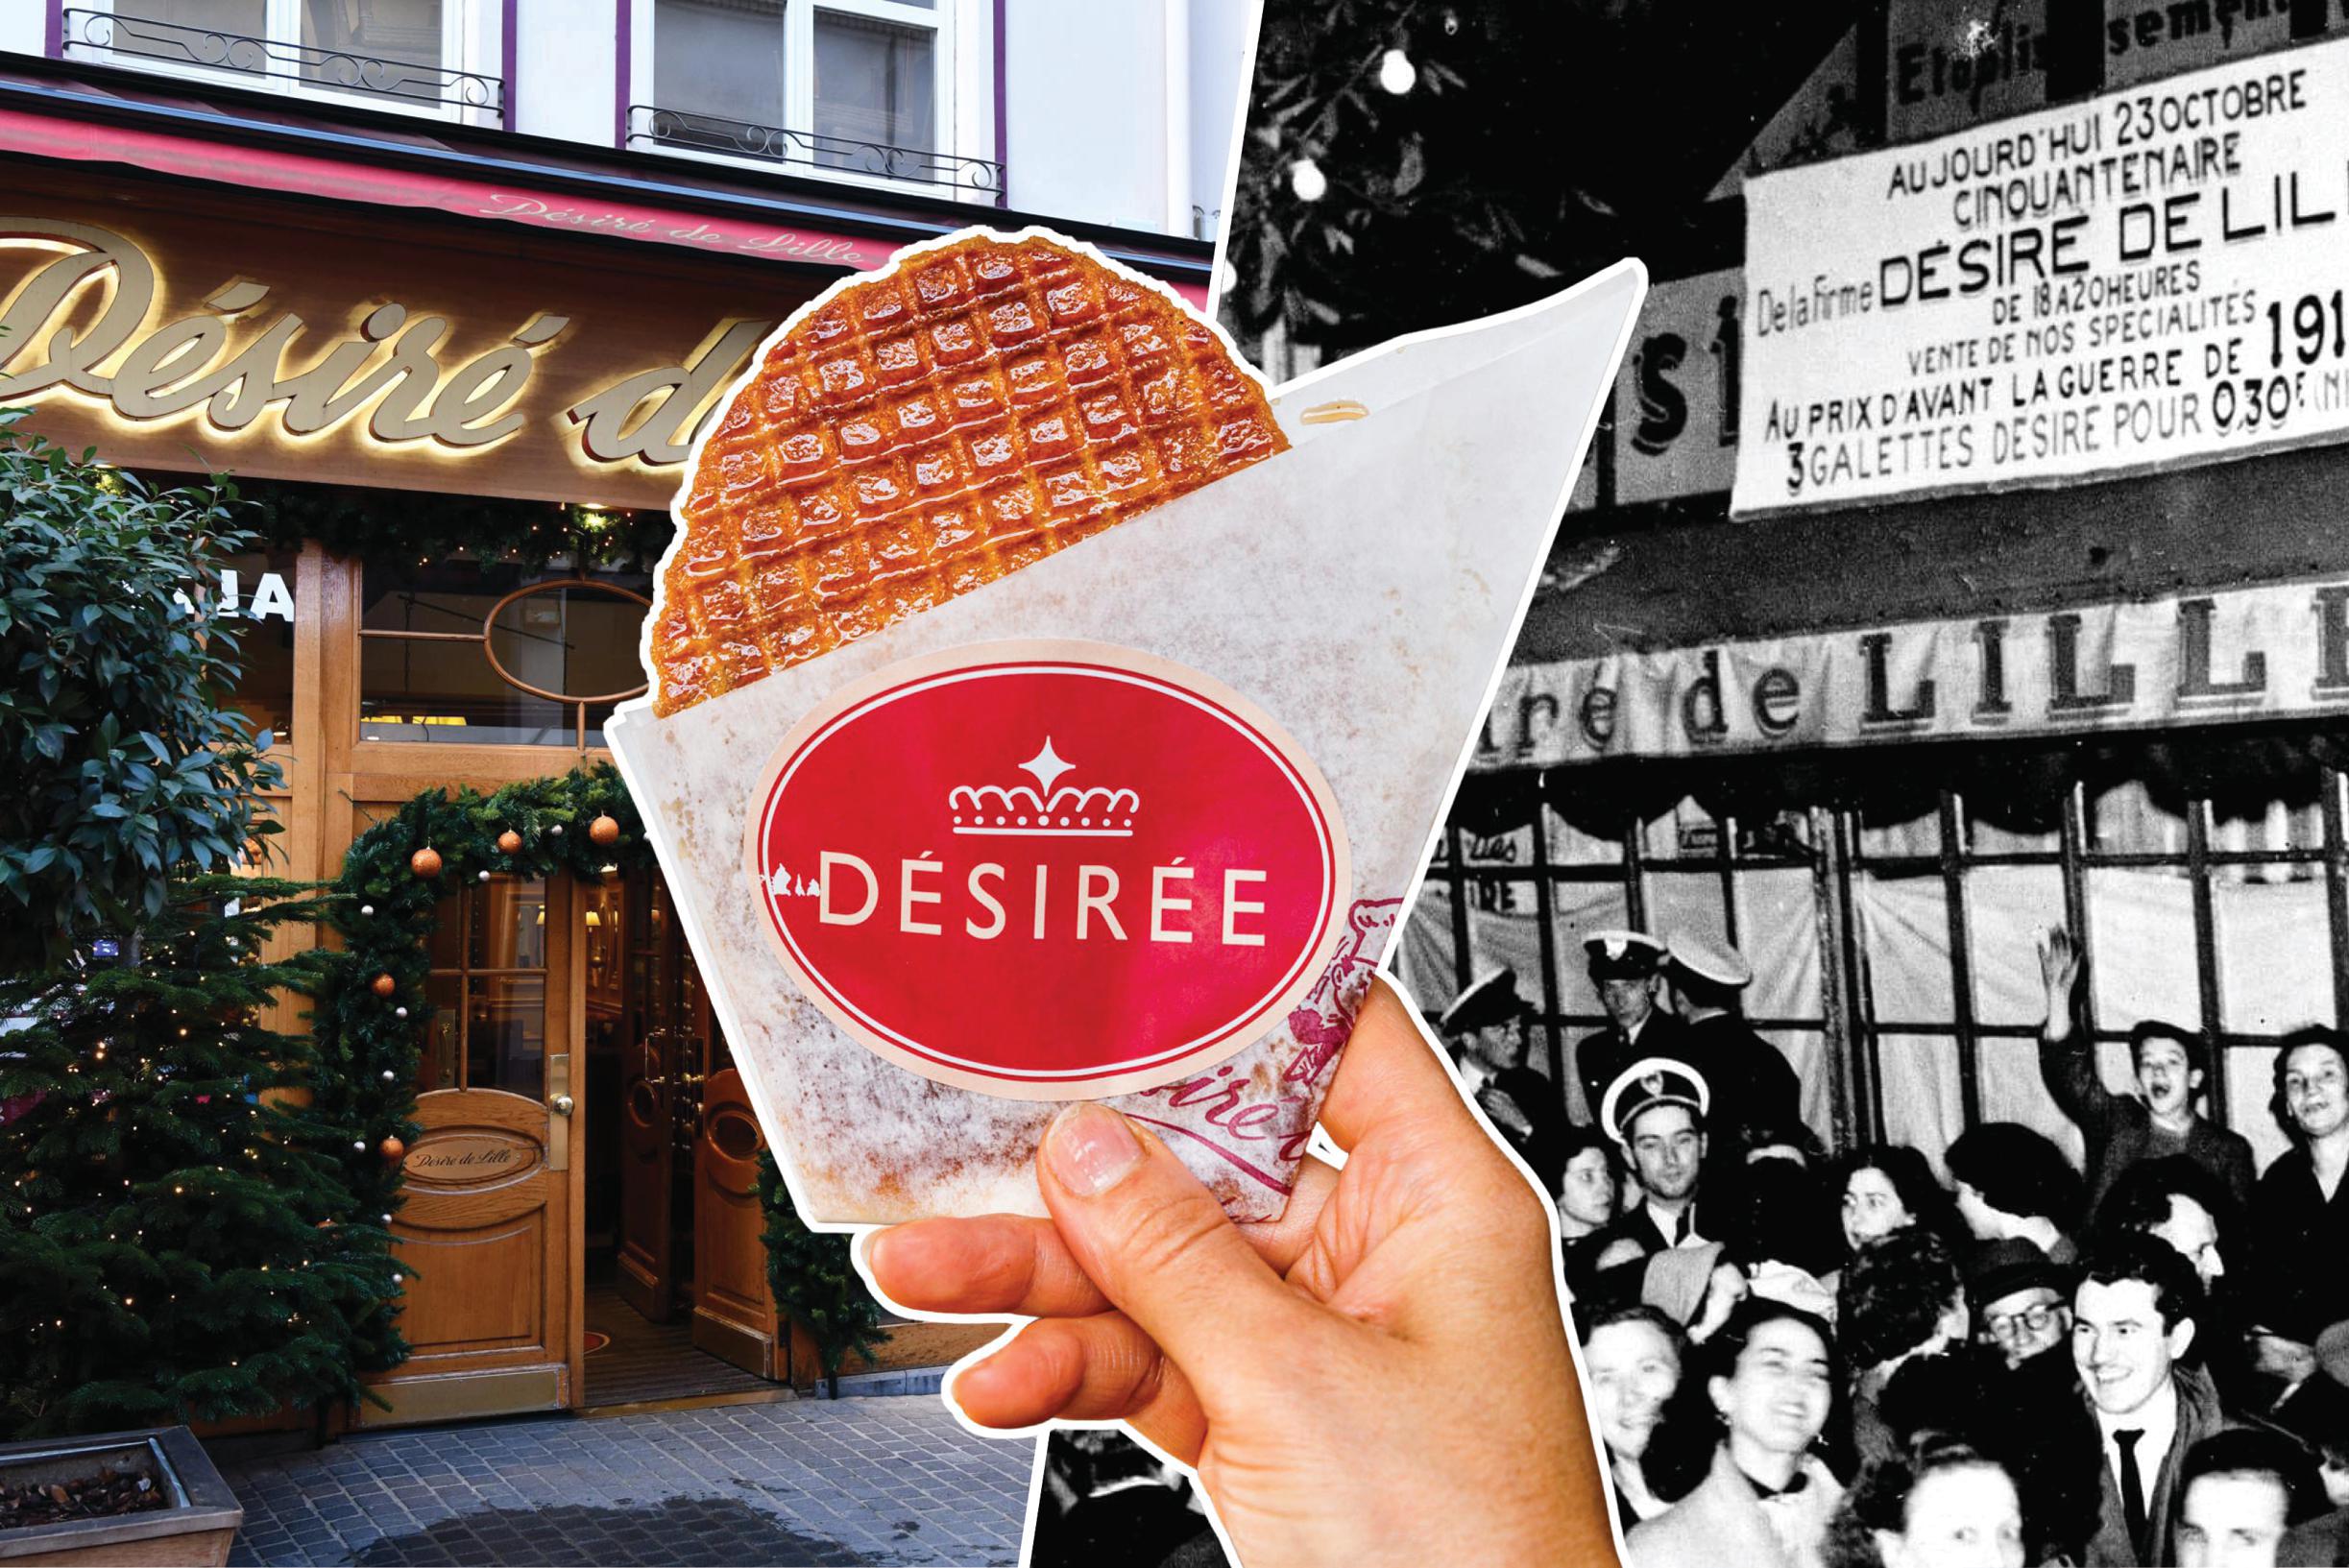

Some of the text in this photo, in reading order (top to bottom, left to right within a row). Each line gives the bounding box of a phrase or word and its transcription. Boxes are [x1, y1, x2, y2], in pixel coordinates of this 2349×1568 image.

[1887, 113, 2101, 200] AUJOURD'HUI
[1953, 131, 2241, 227] CINQUANTENAIRE
[479, 192, 866, 265] Désiré de Lille
[2119, 192, 2203, 262] DE
[0, 215, 570, 445] Désiré
[1908, 339, 1978, 376] VENTE
[1988, 333, 2016, 365] DE
[2026, 322, 2074, 356] NOS
[1993, 294, 2022, 326] DE
[1809, 396, 1872, 435] PRIX
[1881, 377, 1994, 425] D'AVANT
[2013, 369, 2048, 407] LA
[2059, 349, 2183, 398] GUERRE
[2205, 337, 2242, 379] DE
[1787, 442, 1804, 489] 3
[1810, 423, 1973, 486] GALETTES
[2114, 392, 2202, 447] POUR
[1683, 648, 1800, 745] de
[819, 851, 1267, 947] DÉSIRÉE
[459, 1152, 474, 1165] de
